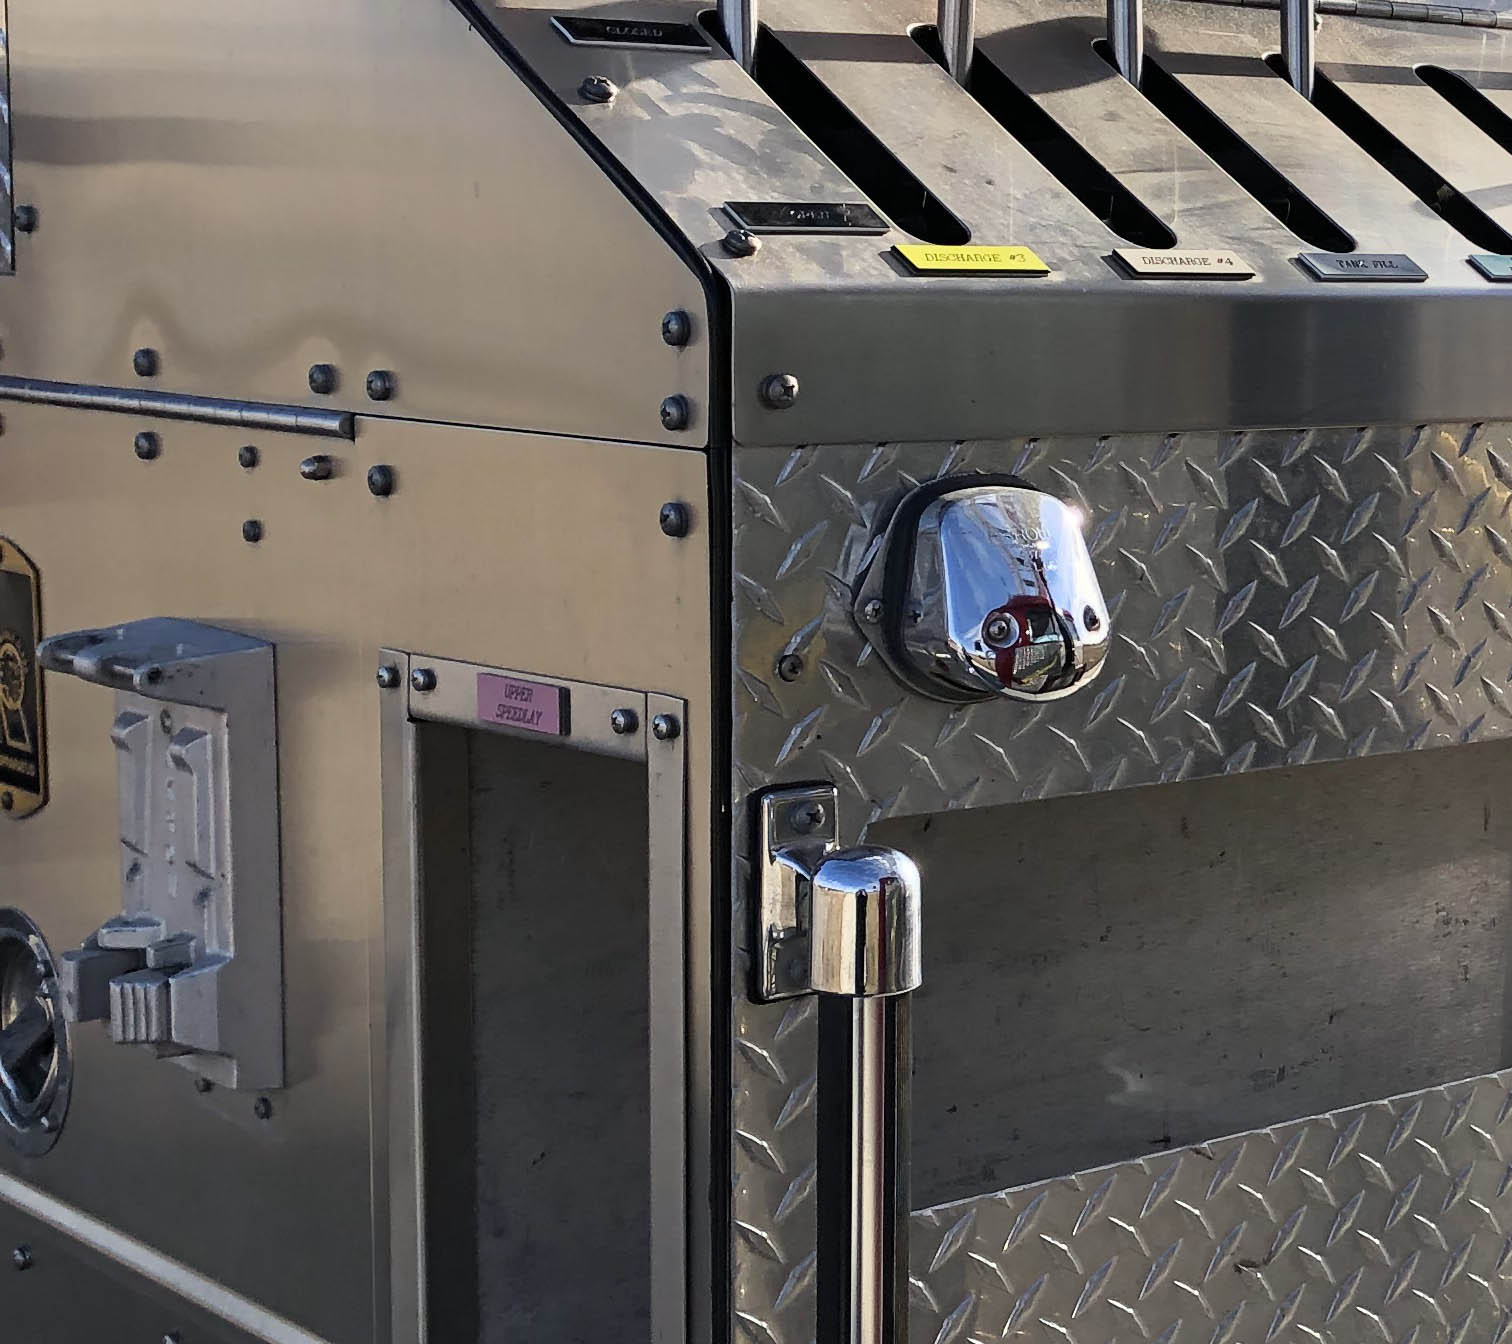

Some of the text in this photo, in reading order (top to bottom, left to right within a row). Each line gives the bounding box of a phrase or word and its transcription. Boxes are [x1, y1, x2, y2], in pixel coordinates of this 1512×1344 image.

[924, 253, 1027, 263] DISCHARGE #3
[1142, 256, 1233, 266] DISCHARGE #4
[1336, 259, 1399, 269] TANK FILL
[504, 683, 533, 703] UPPER
